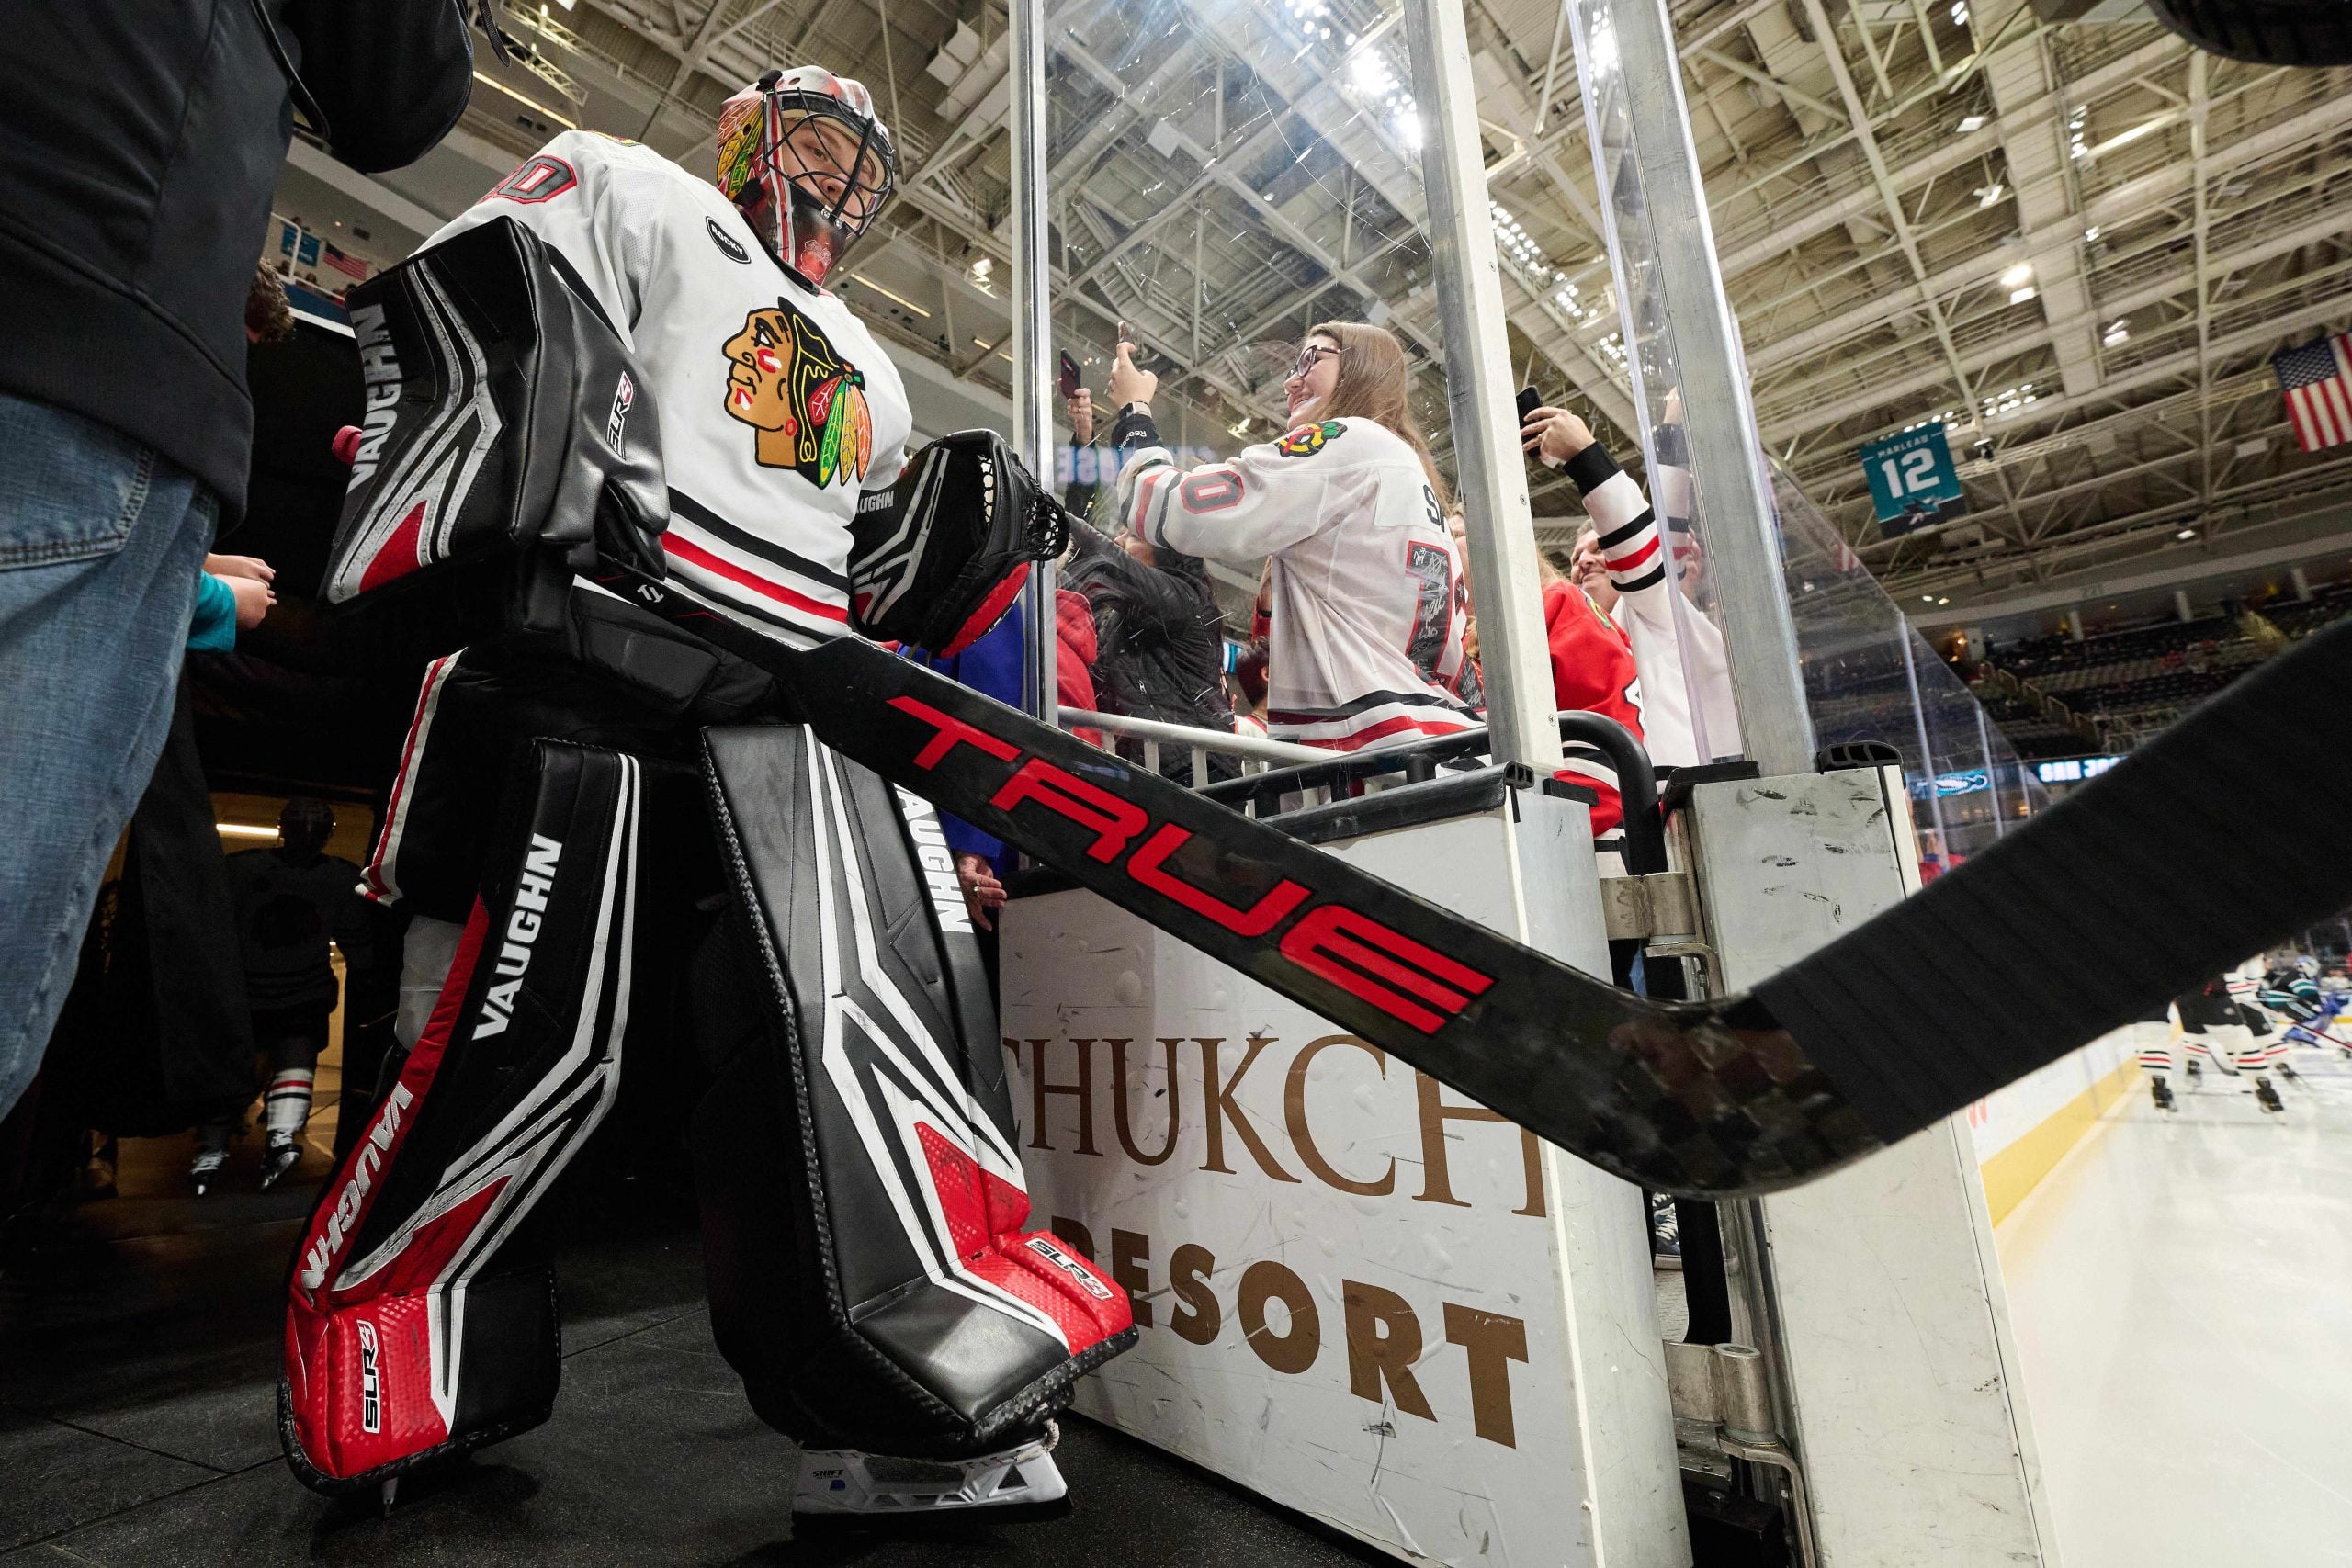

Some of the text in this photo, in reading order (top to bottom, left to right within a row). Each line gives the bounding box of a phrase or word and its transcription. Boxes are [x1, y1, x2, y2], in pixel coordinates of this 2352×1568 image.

[711, 223, 744, 255] ROCKY
[345, 303, 402, 494] VAUGHN
[1118, 430, 1148, 452] Reebok
[1877, 434, 1929, 458] MARLEAU
[1881, 447, 1940, 499] 12
[856, 490, 895, 514] UGHN
[1423, 484, 1446, 533] S
[2039, 760, 2082, 782] SAN
[886, 695, 1498, 1035] TRUE
[892, 782, 974, 934] AUGHN
[471, 832, 563, 1041] VAUGHN
[1002, 1033, 1547, 1218] HUKCH
[359, 1323, 379, 1429] SLR4
